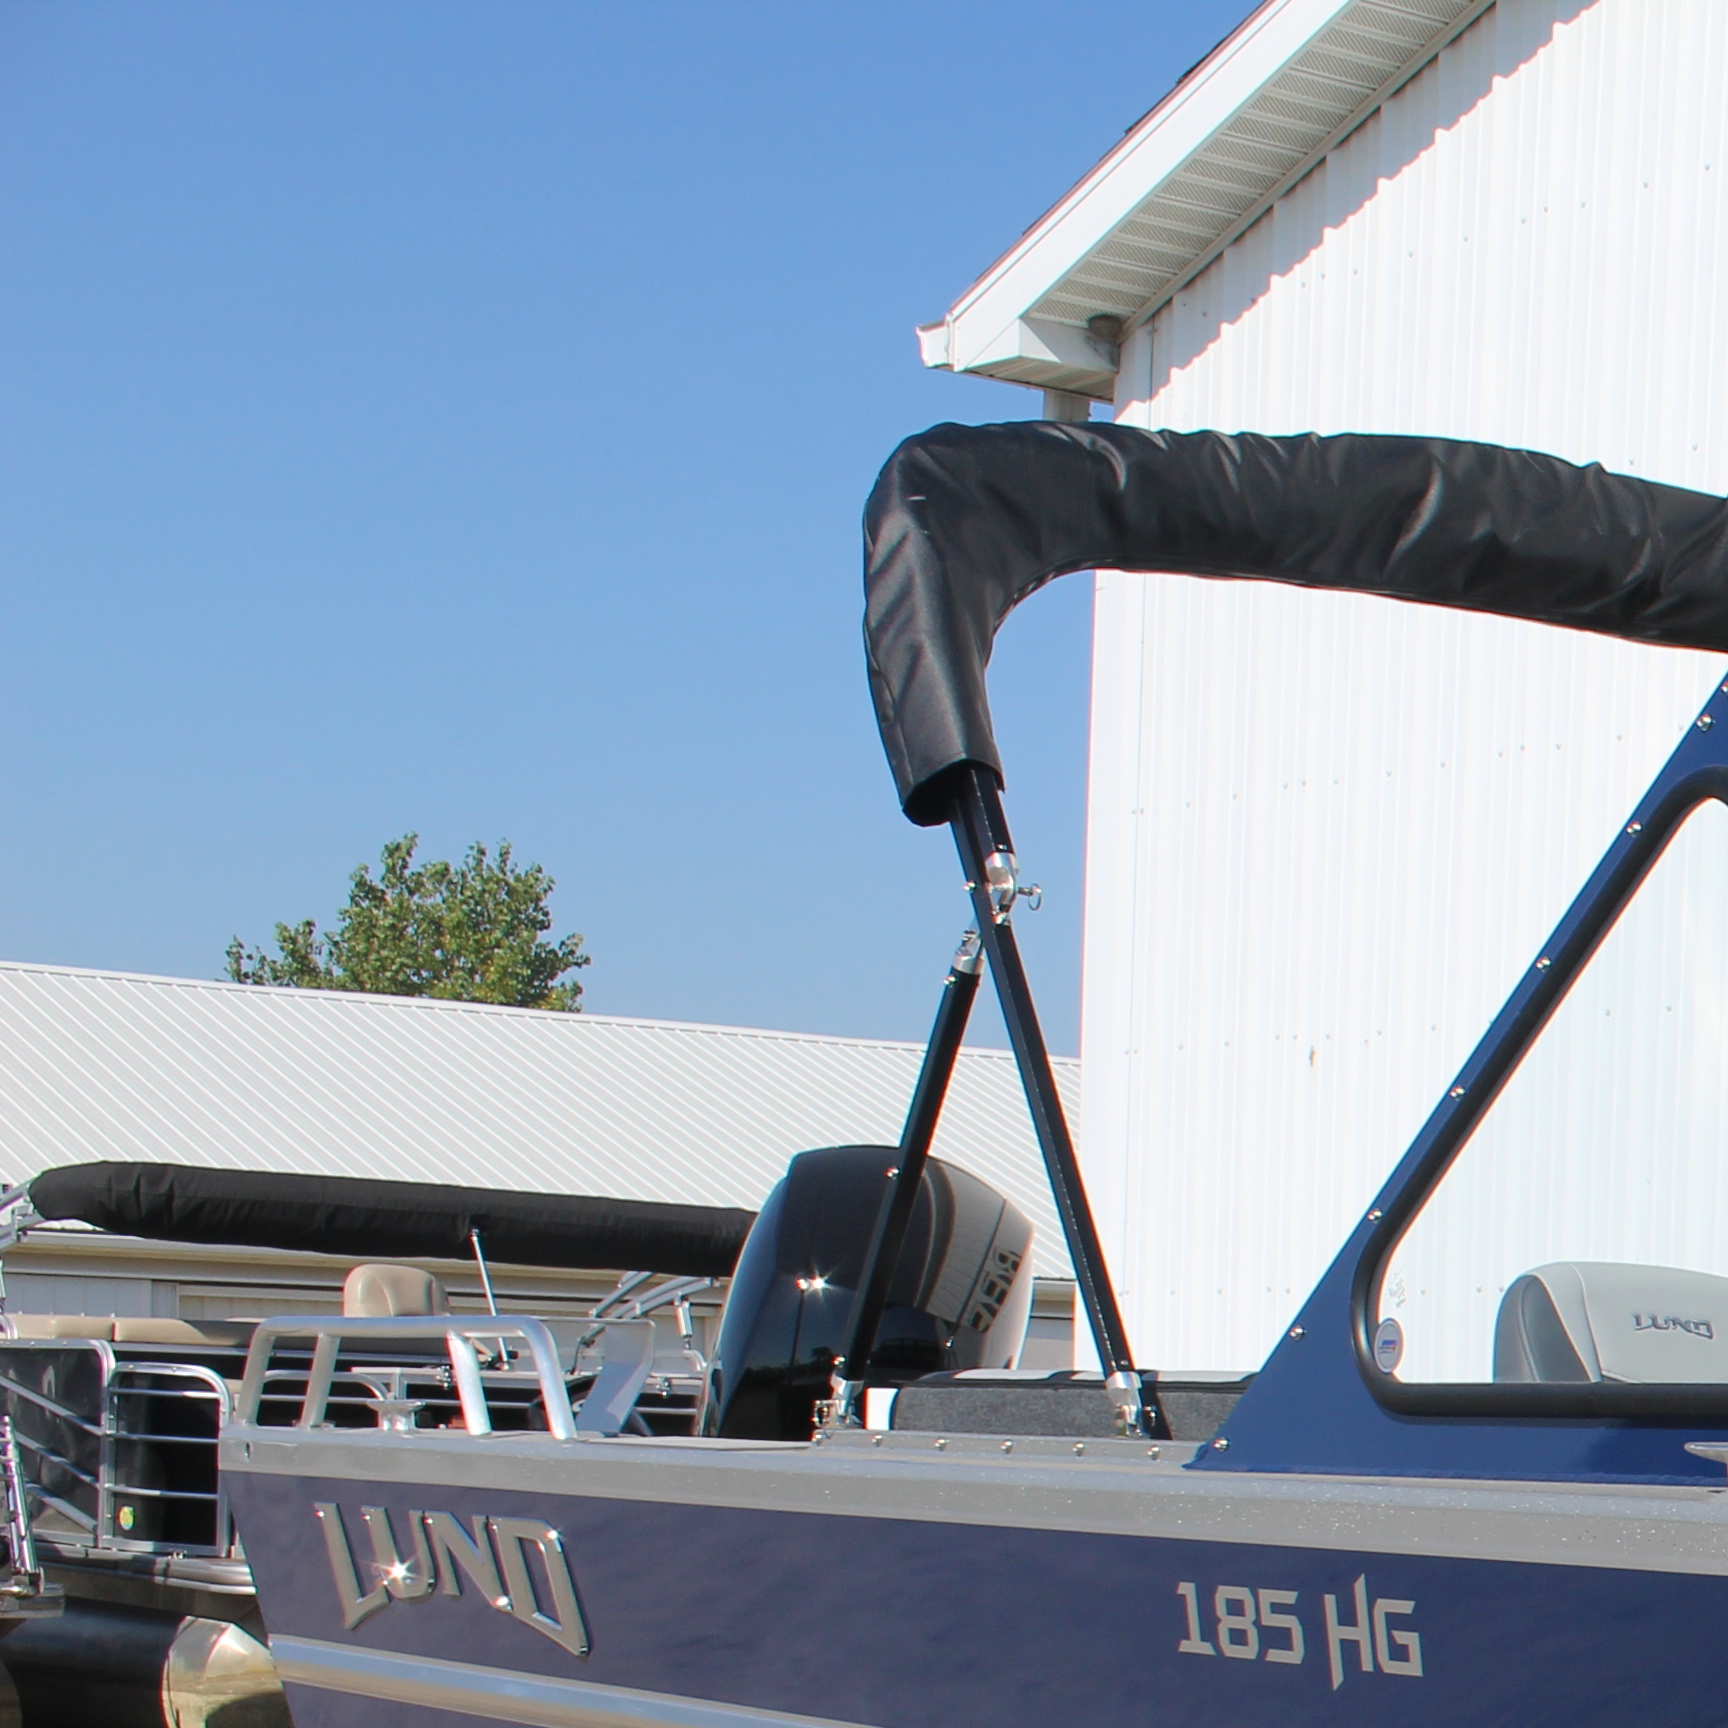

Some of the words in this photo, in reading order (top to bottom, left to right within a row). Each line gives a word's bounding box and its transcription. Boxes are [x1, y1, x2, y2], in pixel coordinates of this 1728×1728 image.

[1632, 1313, 1714, 1341] LUND
[314, 1502, 591, 1658] LUND
[1176, 1581, 1305, 1665] 185
[1323, 1573, 1424, 1691] HG
